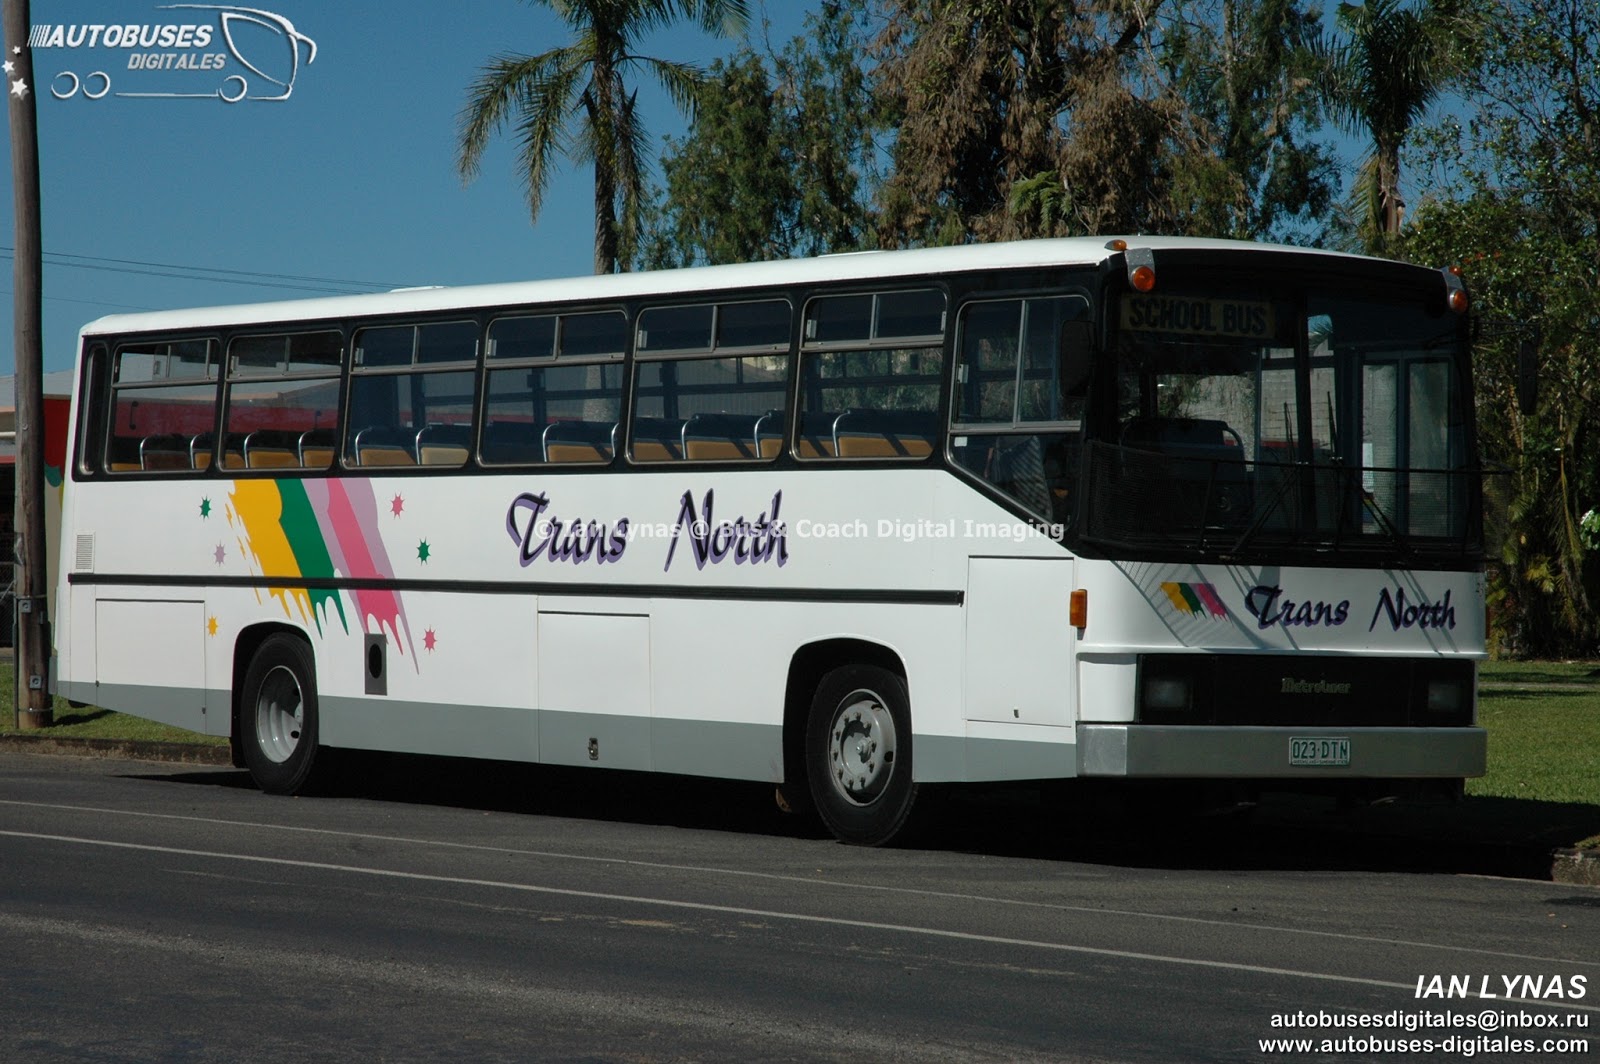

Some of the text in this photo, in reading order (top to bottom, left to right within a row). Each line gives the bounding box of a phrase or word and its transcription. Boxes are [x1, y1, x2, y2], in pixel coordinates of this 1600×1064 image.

[1128, 297, 1267, 336] SCHOOL BUS
[506, 488, 789, 572] Trans North
[1244, 584, 1457, 633] Trans North
